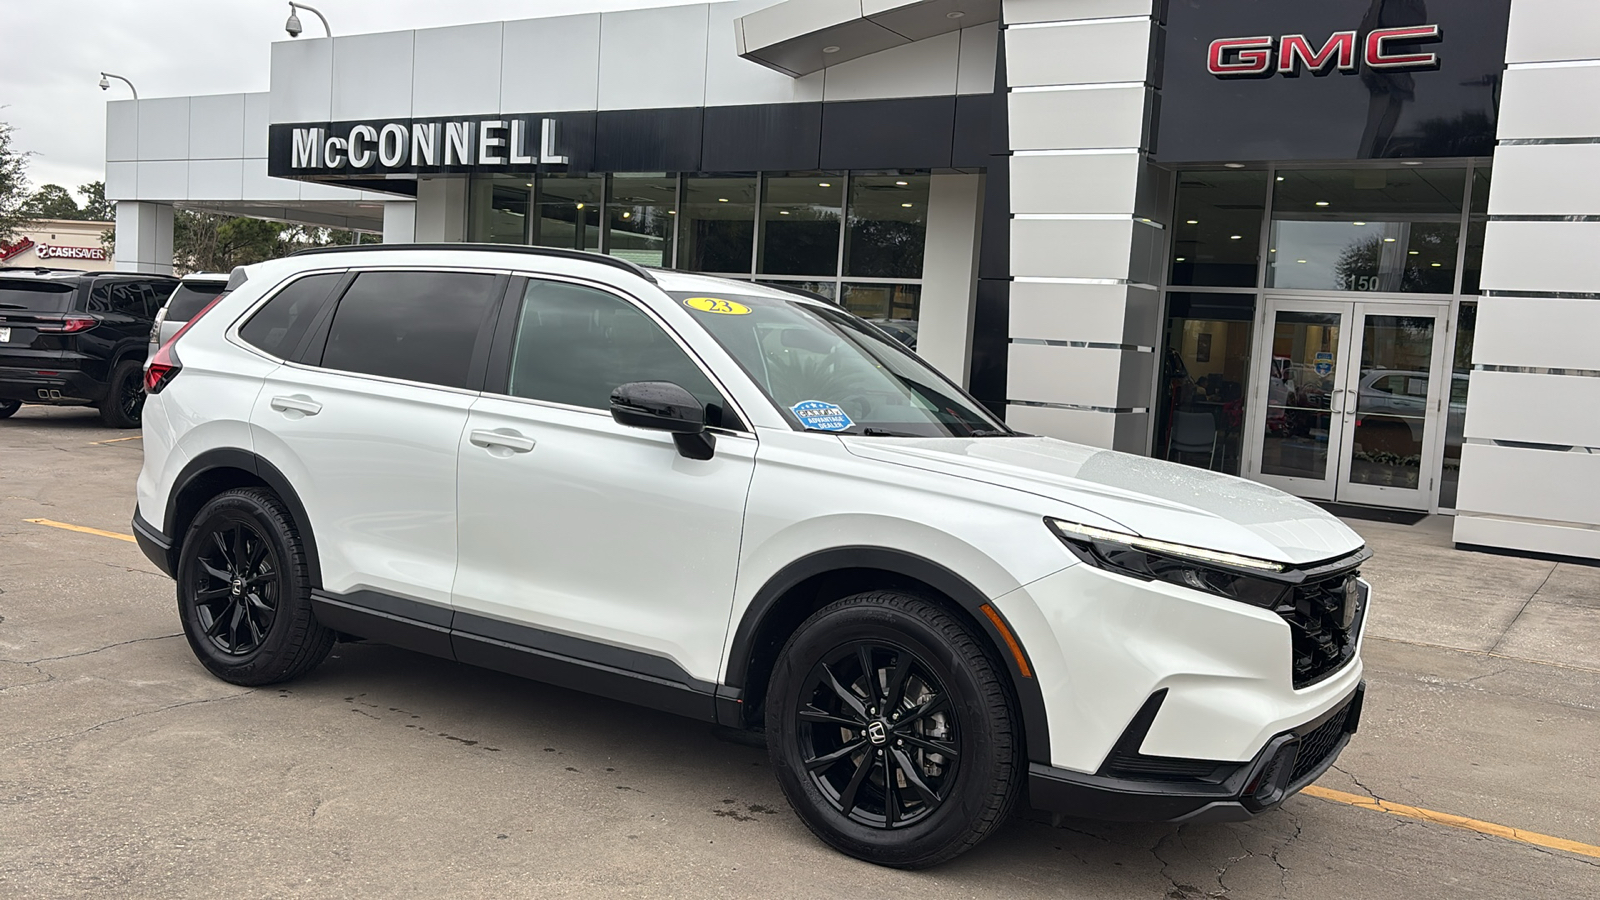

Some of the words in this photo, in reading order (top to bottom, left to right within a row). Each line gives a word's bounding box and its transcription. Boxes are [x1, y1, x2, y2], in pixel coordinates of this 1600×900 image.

[1207, 24, 1442, 78] GMC
[291, 118, 569, 169] McCONNELL
[704, 299, 733, 313] 23
[807, 416, 845, 424] ADVANTAGE
